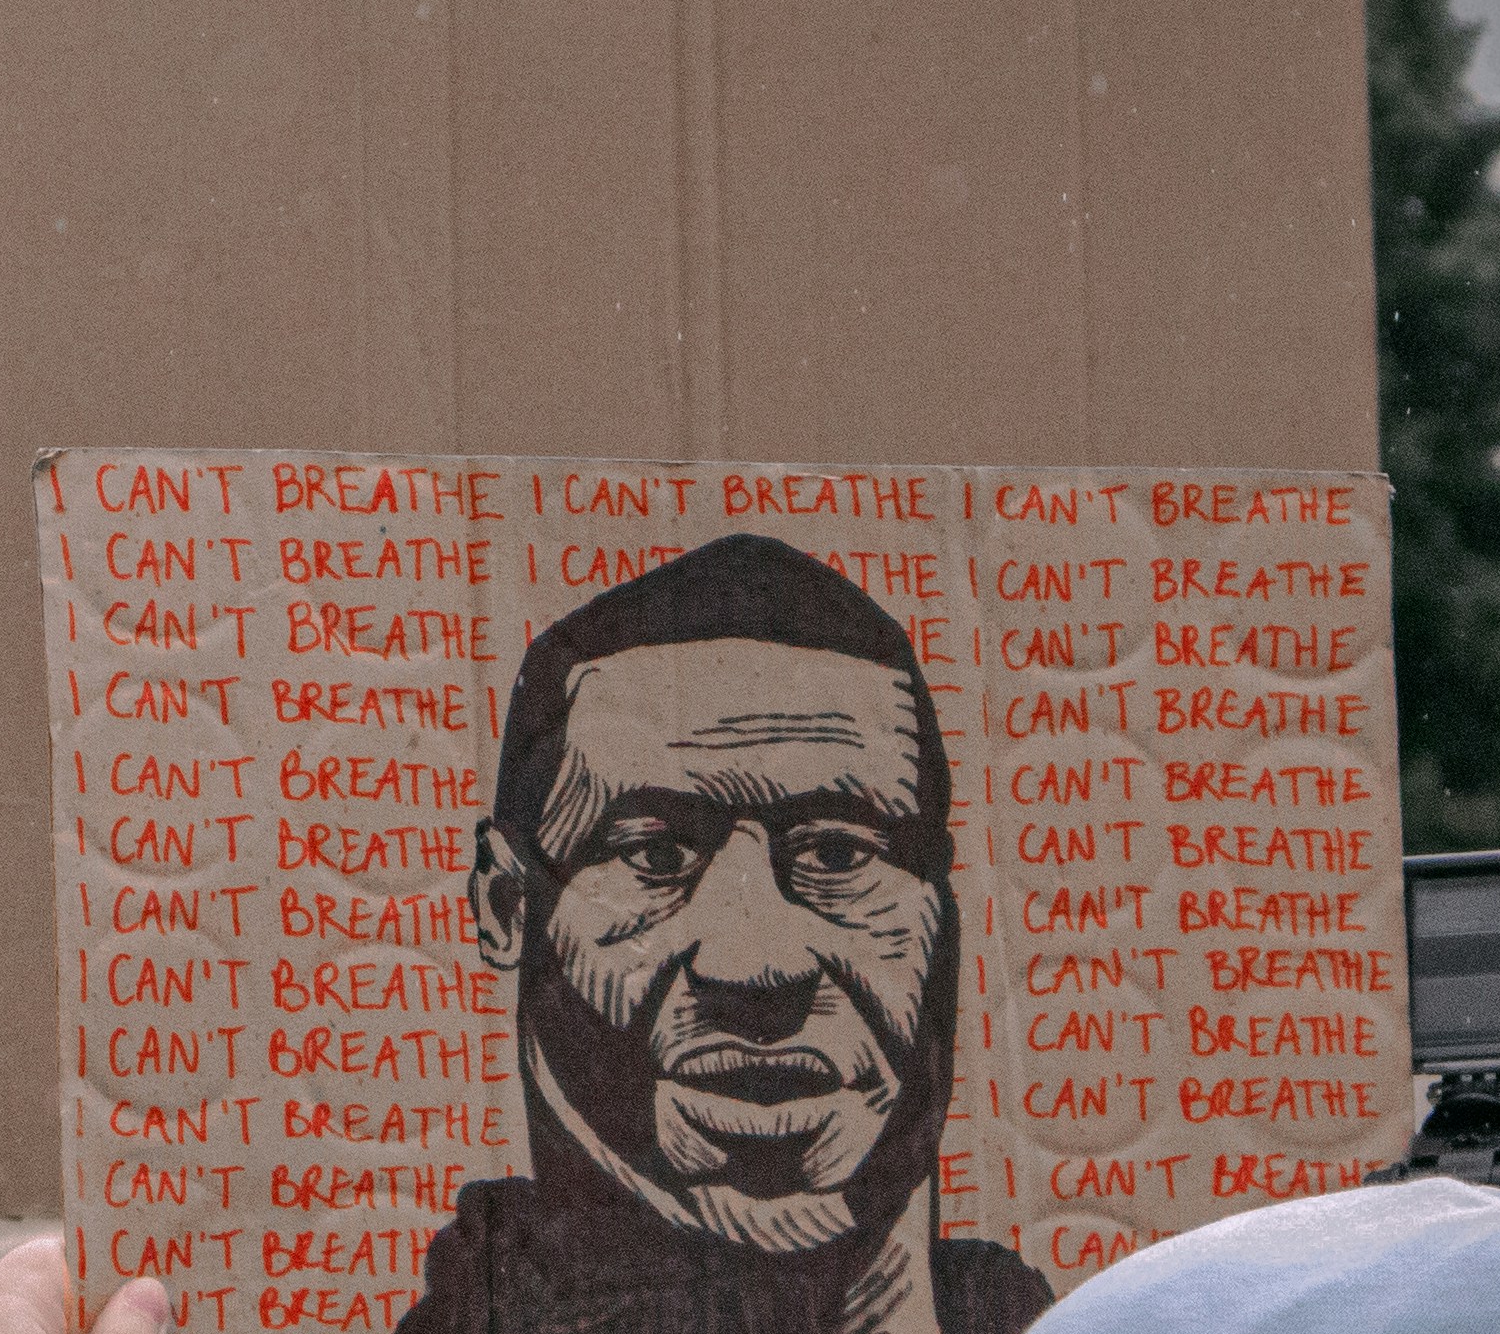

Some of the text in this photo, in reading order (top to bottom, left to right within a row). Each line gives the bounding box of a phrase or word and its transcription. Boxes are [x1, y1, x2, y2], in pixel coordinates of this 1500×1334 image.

[48, 461, 1353, 529] I CAN'T BREATHE I CAN'T BREATHE I CAN'T BREATHE
[60, 533, 75, 581] I
[105, 531, 252, 587] CAN'T
[279, 536, 492, 587] BREATHE
[526, 543, 538, 585] I
[968, 557, 979, 599] I
[996, 557, 1127, 604] CAN'T
[1148, 557, 1369, 605] BREATHE
[67, 601, 77, 643] I
[102, 598, 257, 659] CAN'T
[286, 599, 498, 663] BREATHE
[972, 627, 982, 667] I
[1000, 621, 1124, 672] CAN'T
[1153, 620, 1356, 673] BREATHE
[67, 669, 82, 717] I
[104, 670, 241, 726] CAN'T
[270, 678, 470, 731] BREATHE
[486, 686, 500, 740] I
[982, 694, 990, 736] I
[1003, 679, 1136, 741] CAN'T
[1153, 685, 1369, 739] BREATHE
[73, 749, 87, 794] I
[109, 751, 256, 801] CAN'T
[278, 748, 484, 810] BREATHE
[985, 765, 994, 805] I
[1009, 756, 1143, 806] CAN'T
[1161, 760, 1372, 808] BREATHE
[76, 816, 86, 855] I
[109, 813, 254, 869] CAN'T
[276, 817, 470, 878] BREATHE
[986, 827, 995, 867] I
[1016, 819, 1144, 867] CAN'T
[1165, 823, 1373, 876] BREATHE
[78, 881, 1366, 948] I CAN'T BREATHE I CAN'T BREATHE
[78, 944, 1393, 1016] I CAN'T BREATHE I CAN'T BREATHE
[77, 1003, 1378, 1084] I CAN'T BREATHE I CAN'T BREATHE
[76, 1100, 84, 1137] I
[109, 1096, 261, 1146] CAN'T
[283, 1098, 509, 1150] BREATHE
[989, 1079, 1000, 1118] I
[1023, 1072, 1156, 1122] CAN'T
[1177, 1075, 1380, 1124] BREATHE
[77, 1163, 84, 1199] I
[103, 1159, 245, 1210] CAN'T
[269, 1163, 465, 1214] BREATHE
[1003, 1156, 1016, 1199] I
[1049, 1153, 1191, 1201] CAN'T
[76, 1226, 87, 1281] I
[111, 1228, 244, 1278] CAN'T
[261, 1227, 438, 1279] BREATH
